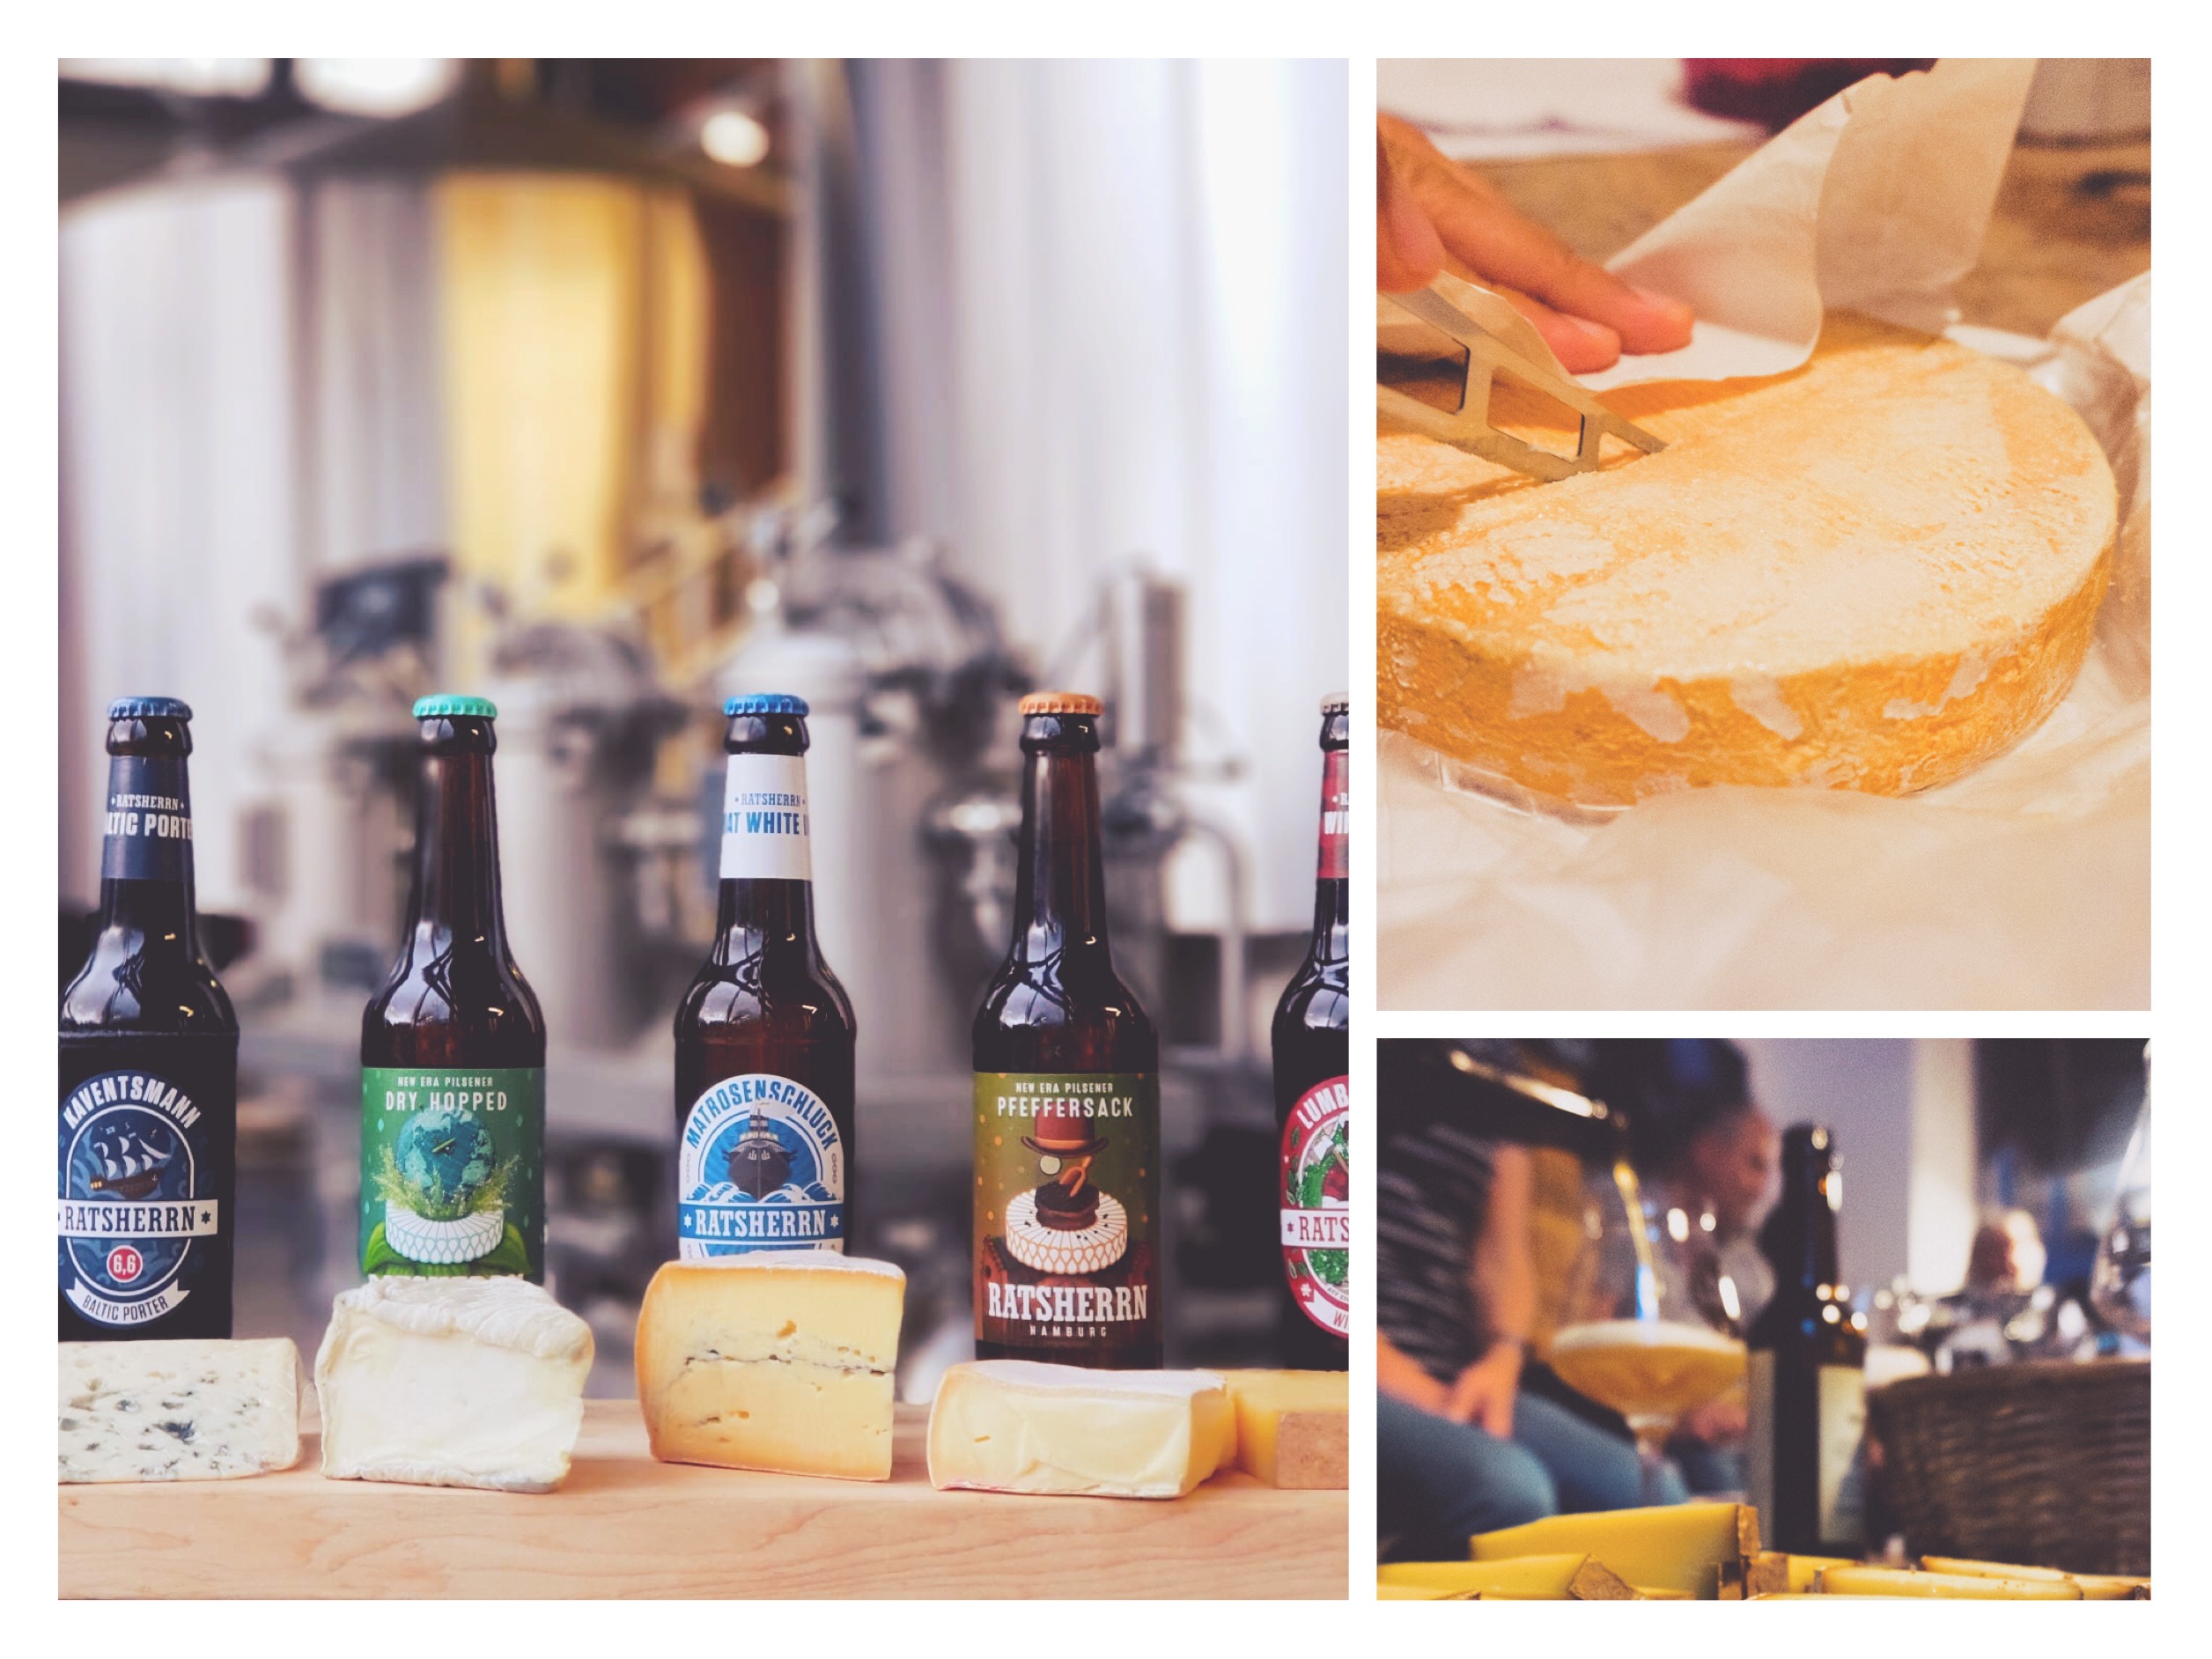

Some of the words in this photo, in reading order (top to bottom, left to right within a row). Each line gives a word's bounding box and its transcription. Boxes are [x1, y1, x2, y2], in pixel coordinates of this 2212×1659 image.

[116, 793, 179, 810] RATSHERRN
[741, 793, 802, 807] RATSHERRN
[746, 812, 800, 835] WHITE
[398, 1076, 416, 1088] NEW
[420, 1076, 439, 1088] ERA
[445, 1076, 493, 1088] PILSENER
[1015, 1082, 1035, 1094] NEW
[1040, 1082, 1059, 1094] ERA
[1065, 1082, 1113, 1094] PILSENER
[63, 1075, 201, 1130] KAVENTSMANN
[386, 1090, 417, 1111] DRY
[430, 1090, 507, 1111] HOPPED
[998, 1096, 1133, 1117] PFEFFERSACK
[1296, 1082, 1349, 1130] LUMB
[686, 1079, 838, 1152] MATROSENSCHLUCK
[65, 1206, 195, 1233] RATSHERRN
[695, 1208, 826, 1238] RATSHERRN
[113, 1254, 136, 1275] 6,6
[83, 1294, 119, 1321] BALTIC
[123, 1295, 169, 1321] PORTER
[988, 1281, 1147, 1322] RATSHERRN
[1029, 1324, 1107, 1338] HAMBURG
